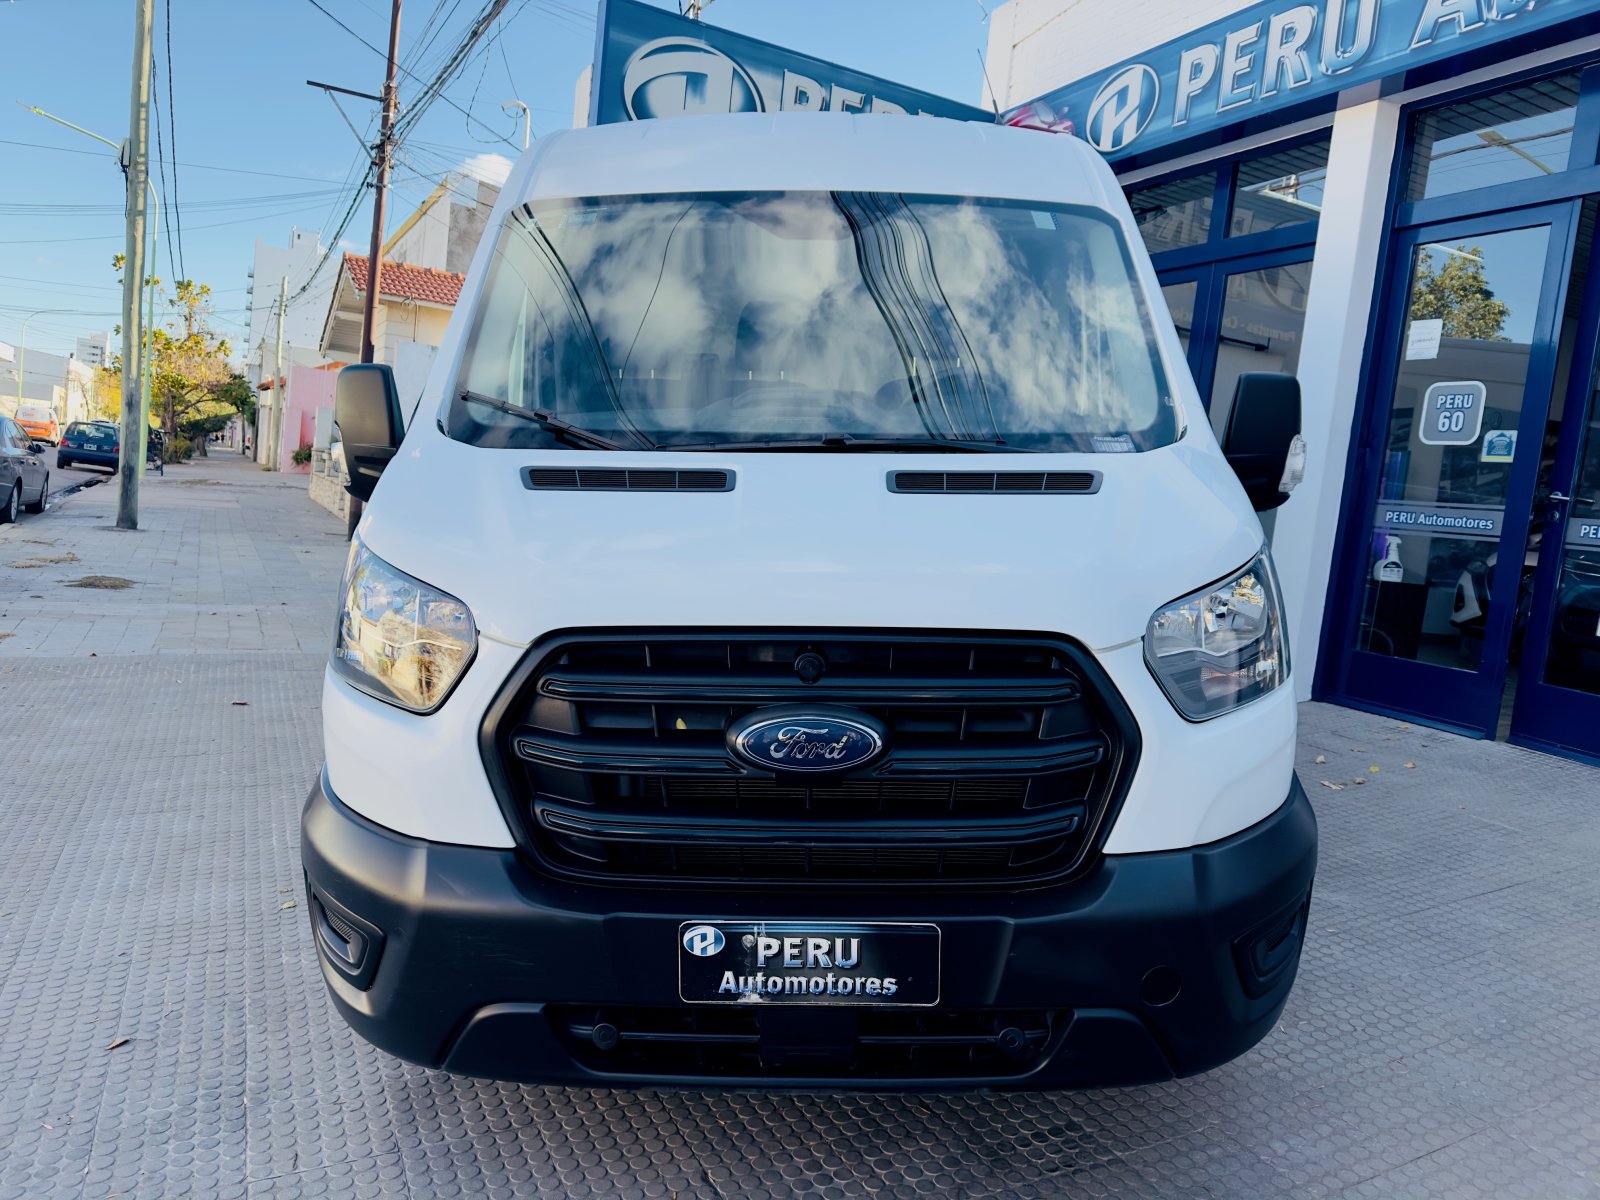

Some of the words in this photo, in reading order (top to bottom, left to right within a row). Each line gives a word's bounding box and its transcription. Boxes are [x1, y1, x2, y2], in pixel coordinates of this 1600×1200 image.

[1172, 0, 1379, 127] PERU
[1436, 394, 1474, 410] PERU
[1438, 411, 1465, 433] 60
[1385, 511, 1415, 524] PERU
[1417, 513, 1494, 530] Automotores
[1580, 525, 1600, 539] PE
[769, 726, 849, 759] Ford
[756, 936, 861, 968] PERU
[718, 971, 899, 996] Automotores
